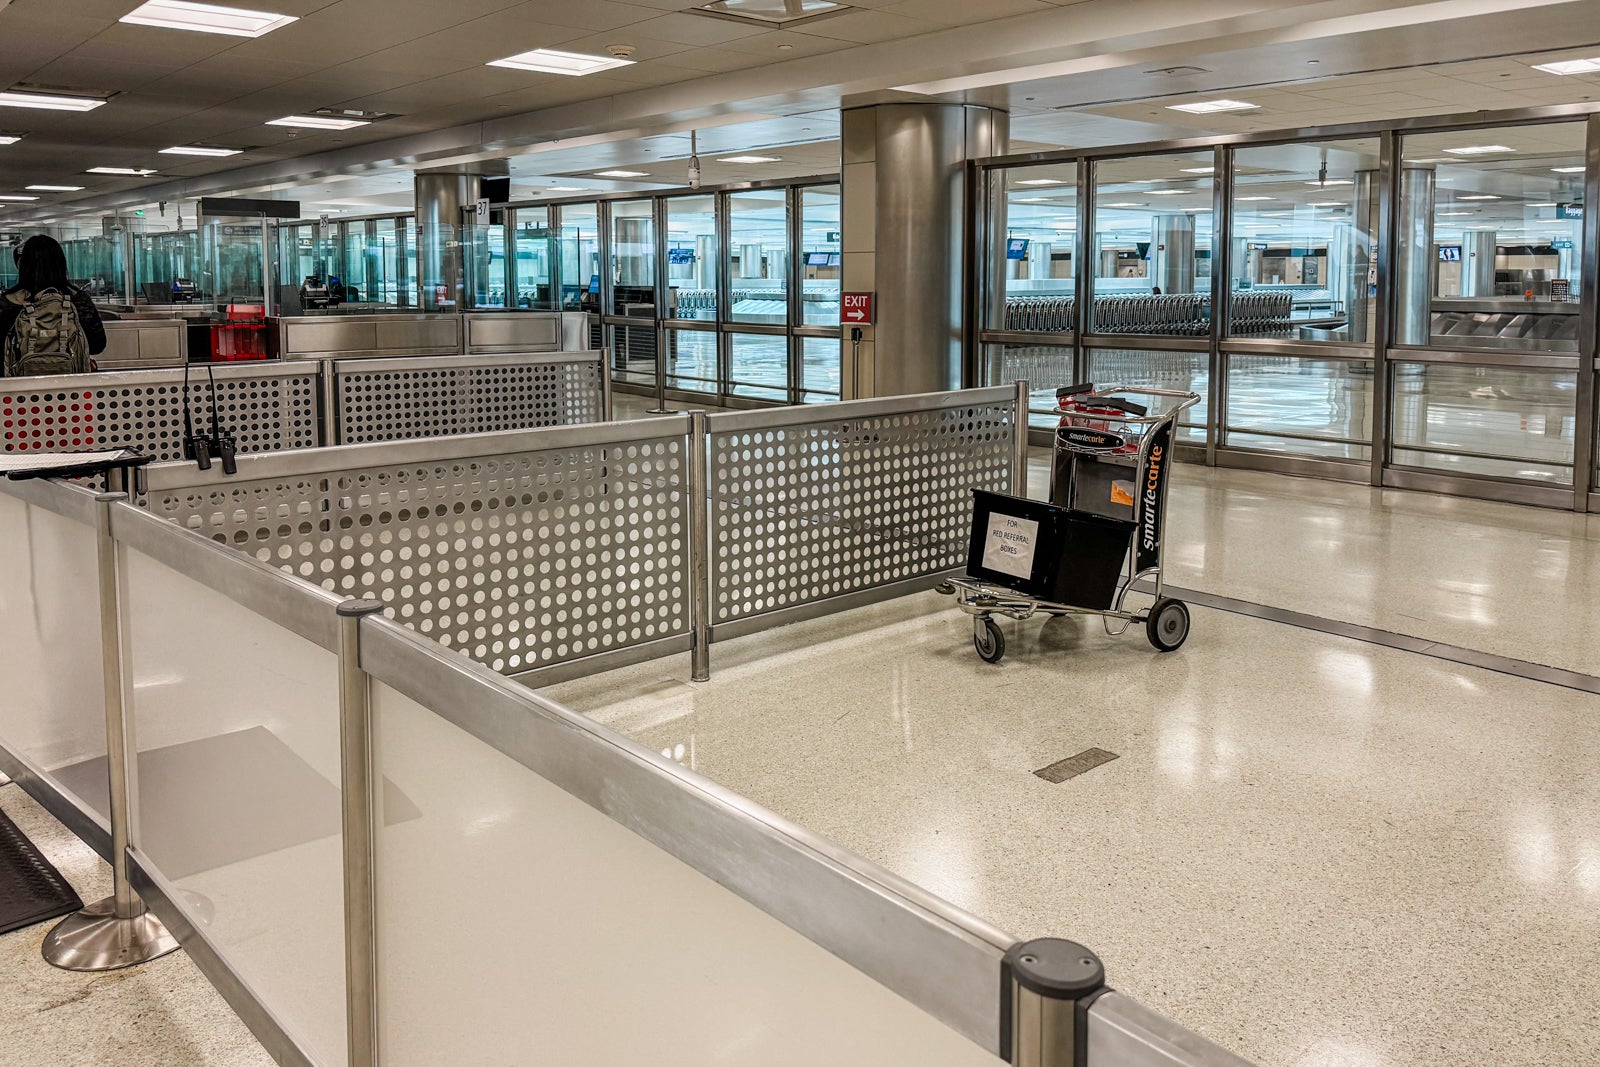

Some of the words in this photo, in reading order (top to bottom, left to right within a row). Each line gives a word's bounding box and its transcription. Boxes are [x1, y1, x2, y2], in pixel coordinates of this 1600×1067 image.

[477, 202, 487, 216] 37
[437, 286, 447, 294] EXIT
[844, 295, 868, 307] EXIT
[1007, 519, 1018, 528] FOR
[992, 529, 1003, 538] RED
[1003, 531, 1029, 545] REFERRAL
[1000, 544, 1018, 555] BOXES
